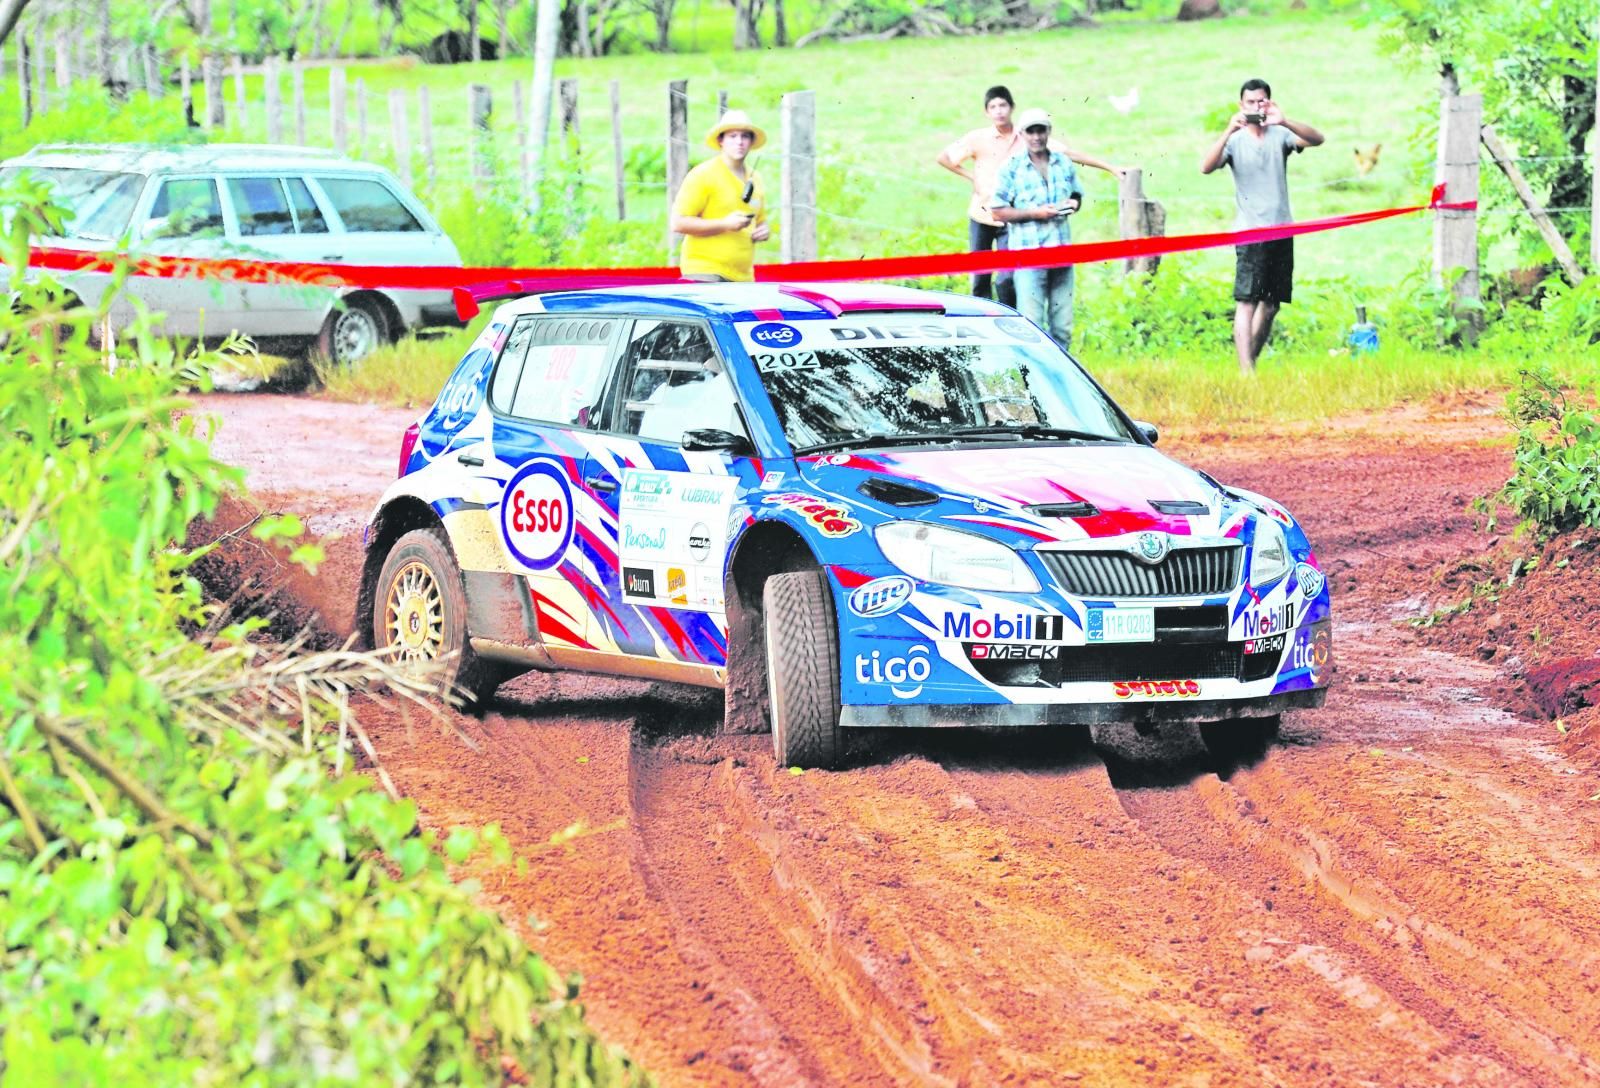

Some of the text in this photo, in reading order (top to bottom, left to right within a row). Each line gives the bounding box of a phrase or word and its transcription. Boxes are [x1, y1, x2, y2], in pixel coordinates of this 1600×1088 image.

[830, 325, 988, 342] DIESA
[759, 352, 818, 370] 202
[681, 488, 723, 504] LUBRAX
[512, 489, 563, 533] Esso
[624, 524, 666, 550] Personal
[632, 574, 650, 593] burn
[944, 611, 1032, 639] Mobil
[1244, 605, 1284, 638] Mobil
[1088, 630, 1103, 640] CZ
[855, 645, 931, 699] tigo
